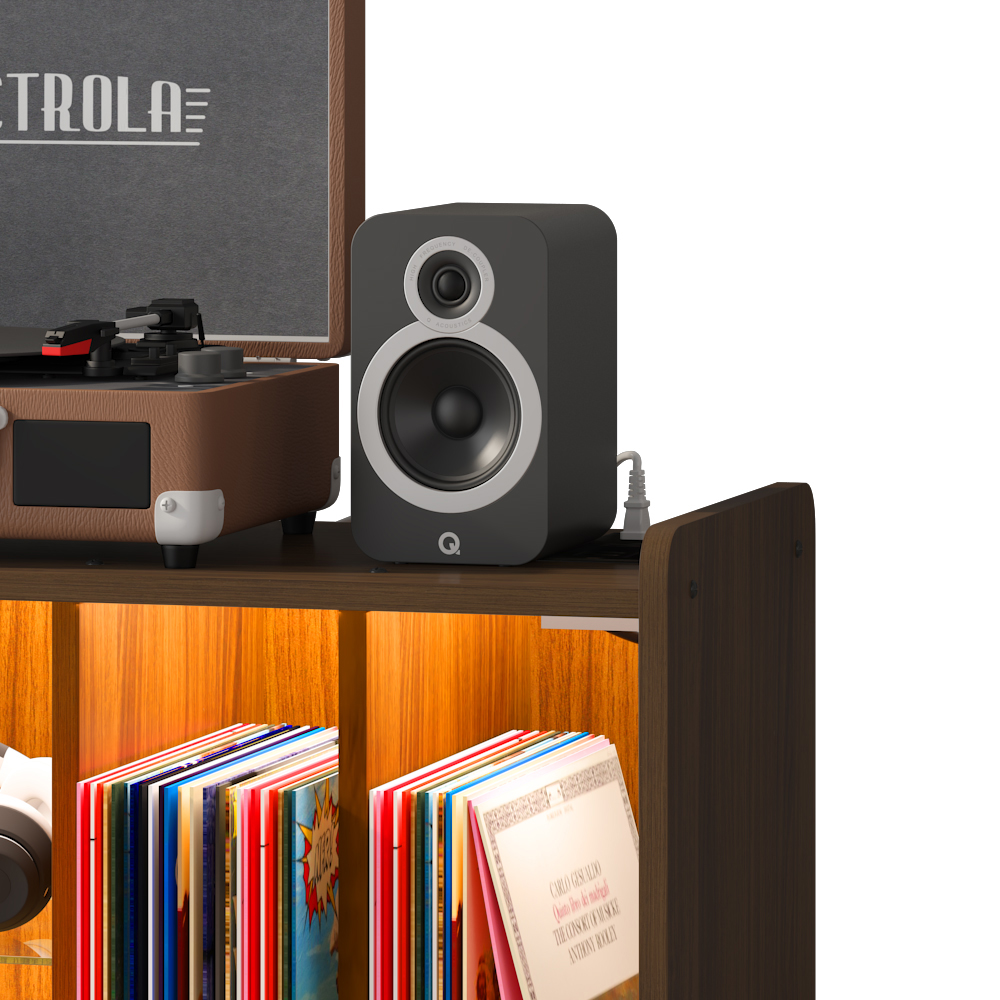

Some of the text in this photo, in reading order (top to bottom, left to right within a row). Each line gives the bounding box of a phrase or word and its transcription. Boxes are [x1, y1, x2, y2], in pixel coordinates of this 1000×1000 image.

[409, 264, 418, 282] HIGH
[419, 241, 456, 259] FREQUENCY
[435, 317, 473, 329] ACOUSTICS
[438, 531, 461, 556] Q
